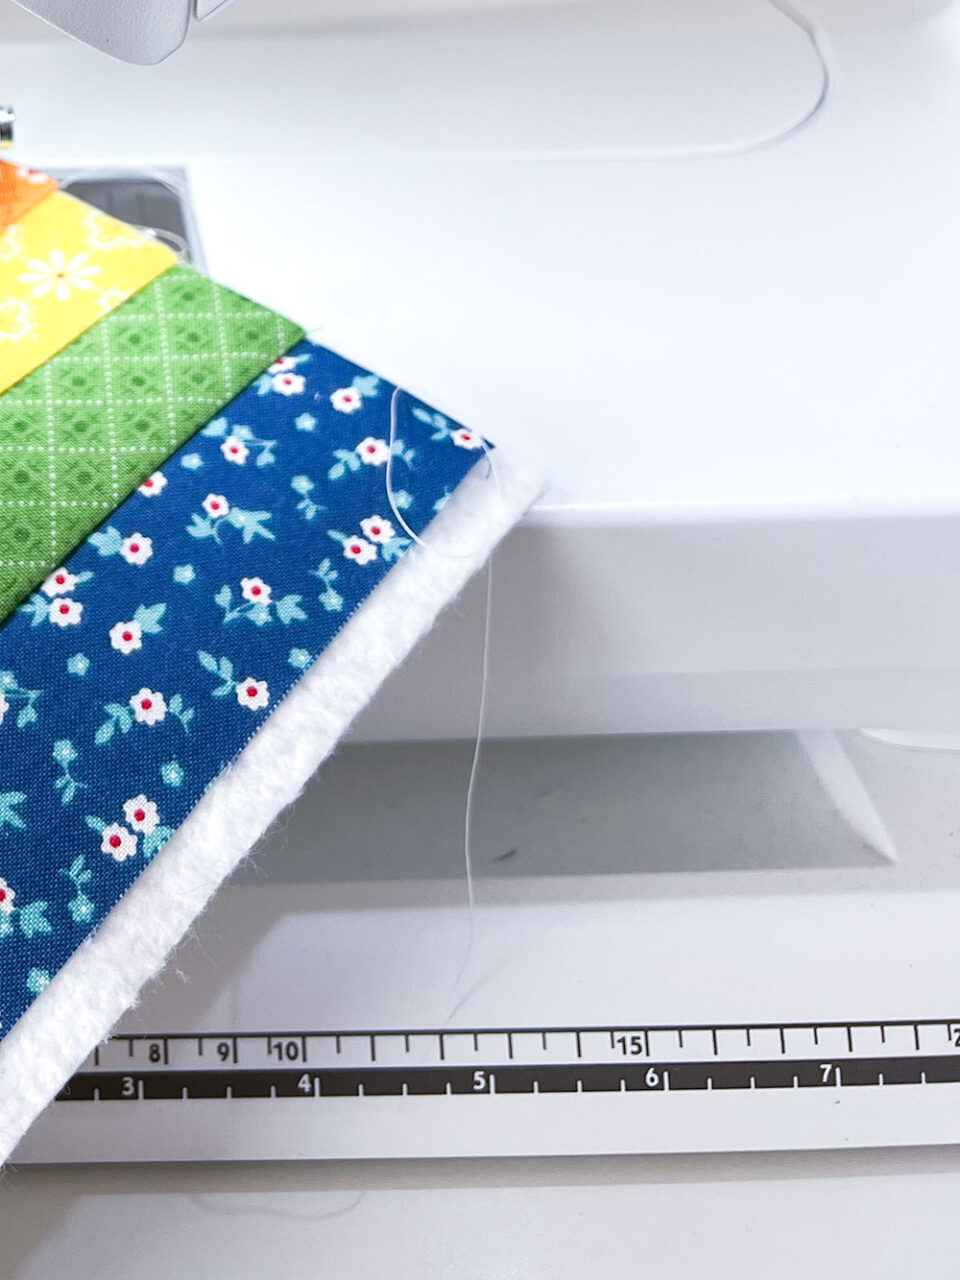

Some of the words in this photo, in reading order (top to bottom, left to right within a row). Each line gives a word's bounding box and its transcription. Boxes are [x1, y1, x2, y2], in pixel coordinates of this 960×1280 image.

[148, 1043, 161, 1064] 8
[216, 1041, 230, 1062] 9
[273, 1040, 299, 1062] 10
[616, 1035, 643, 1056] 15
[122, 1076, 135, 1096] 3
[297, 1073, 312, 1093] 4
[472, 1070, 486, 1091] 5
[645, 1067, 660, 1087] 6
[819, 1063, 833, 1083] 7
